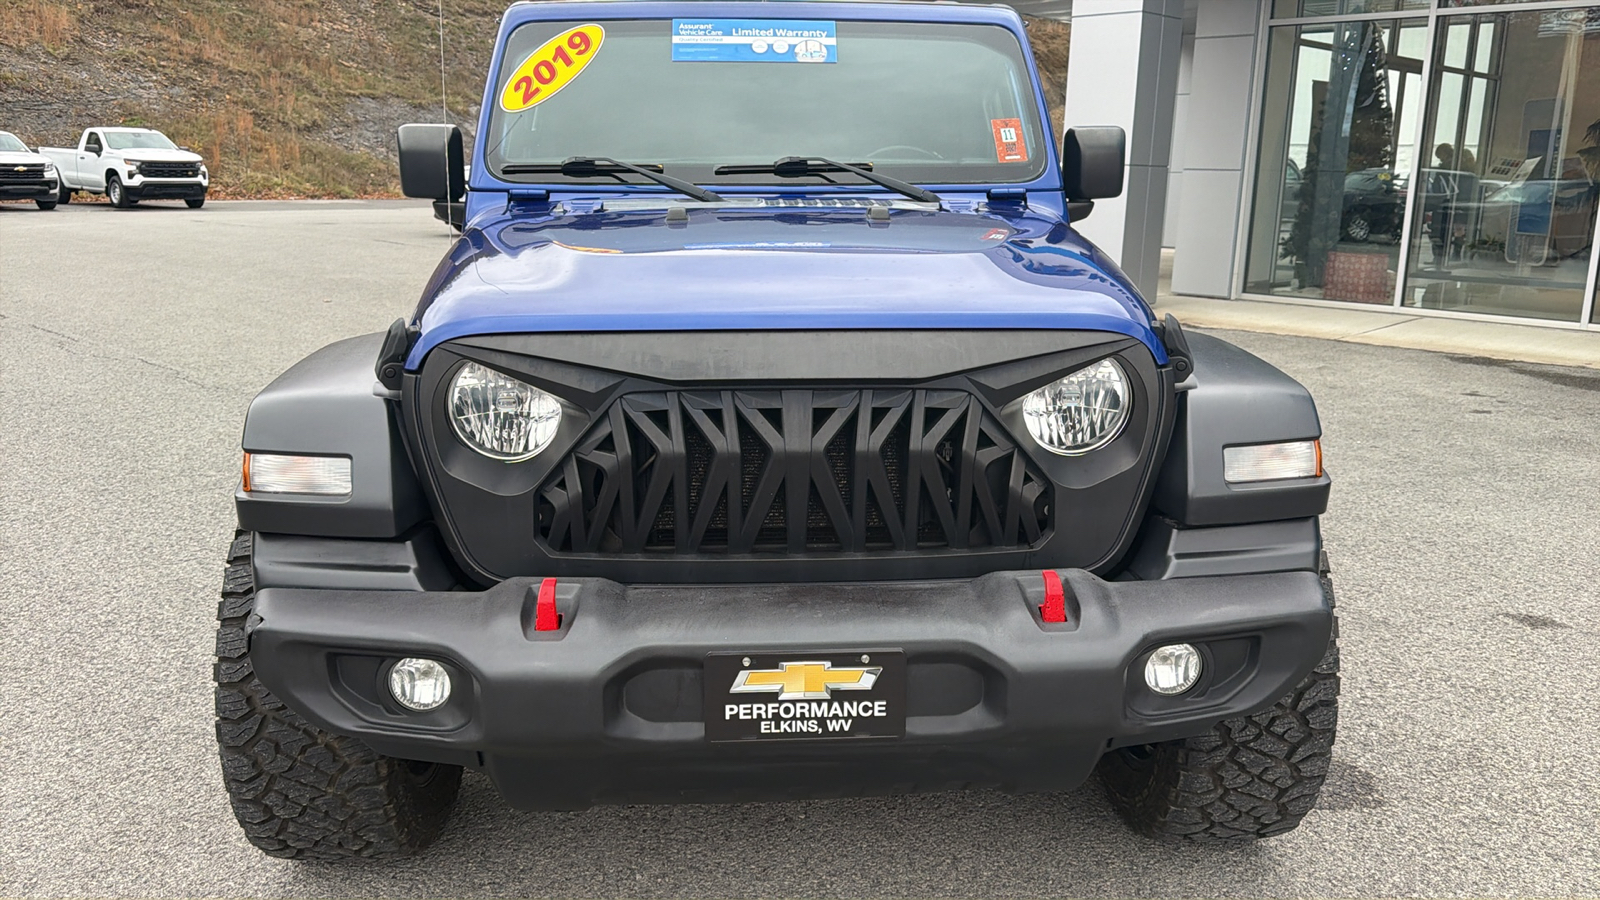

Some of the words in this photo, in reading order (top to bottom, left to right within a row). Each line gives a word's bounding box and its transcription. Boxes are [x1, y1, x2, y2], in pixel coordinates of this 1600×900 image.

[732, 27, 773, 36] Limited
[775, 28, 828, 39] Warranty
[513, 31, 593, 106] 2019
[1003, 129, 1013, 140] 11
[724, 701, 887, 720] PERFORMANCE
[761, 720, 822, 734] ELKINS,
[826, 719, 852, 732] WV
